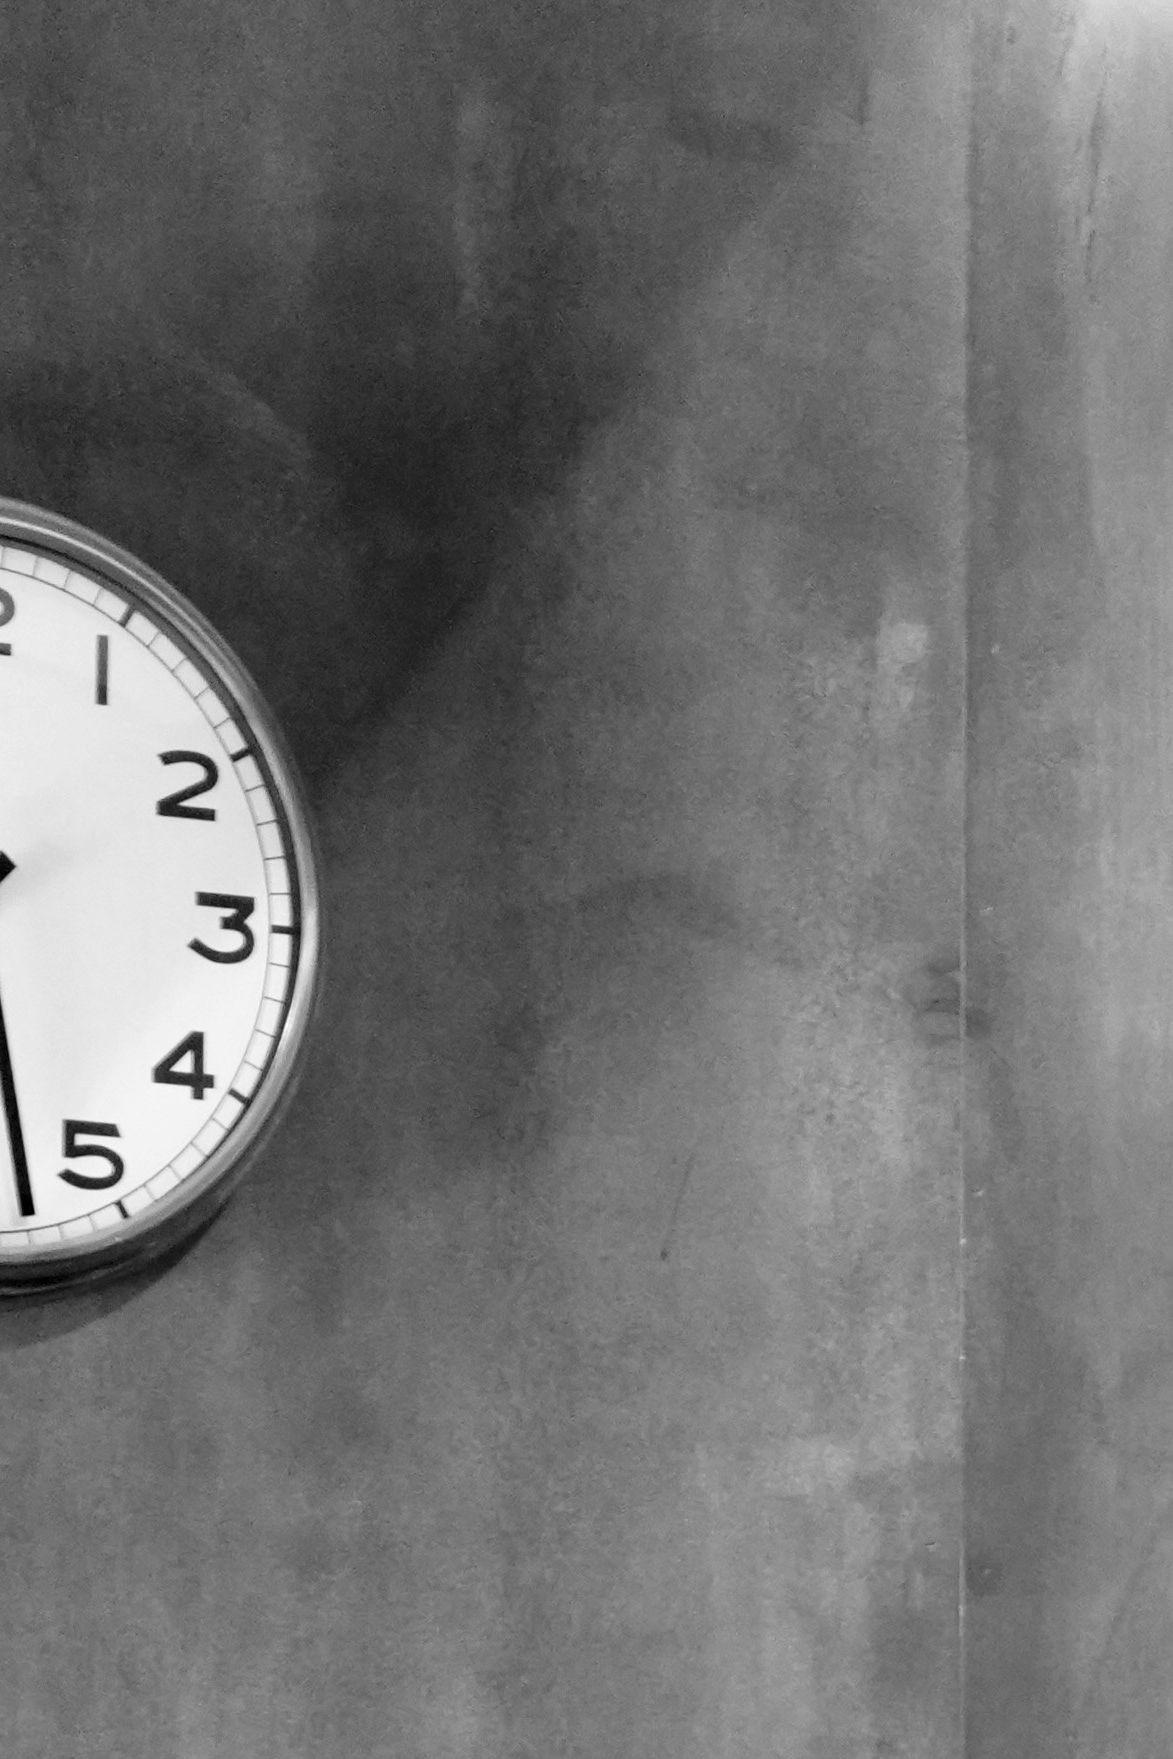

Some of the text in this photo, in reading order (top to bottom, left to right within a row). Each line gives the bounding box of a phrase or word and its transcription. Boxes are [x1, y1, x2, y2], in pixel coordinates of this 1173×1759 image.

[95, 634, 110, 706] 1
[155, 749, 220, 822] 2
[187, 891, 255, 965] 3
[152, 1031, 216, 1101] 4
[57, 1119, 125, 1191] 5
